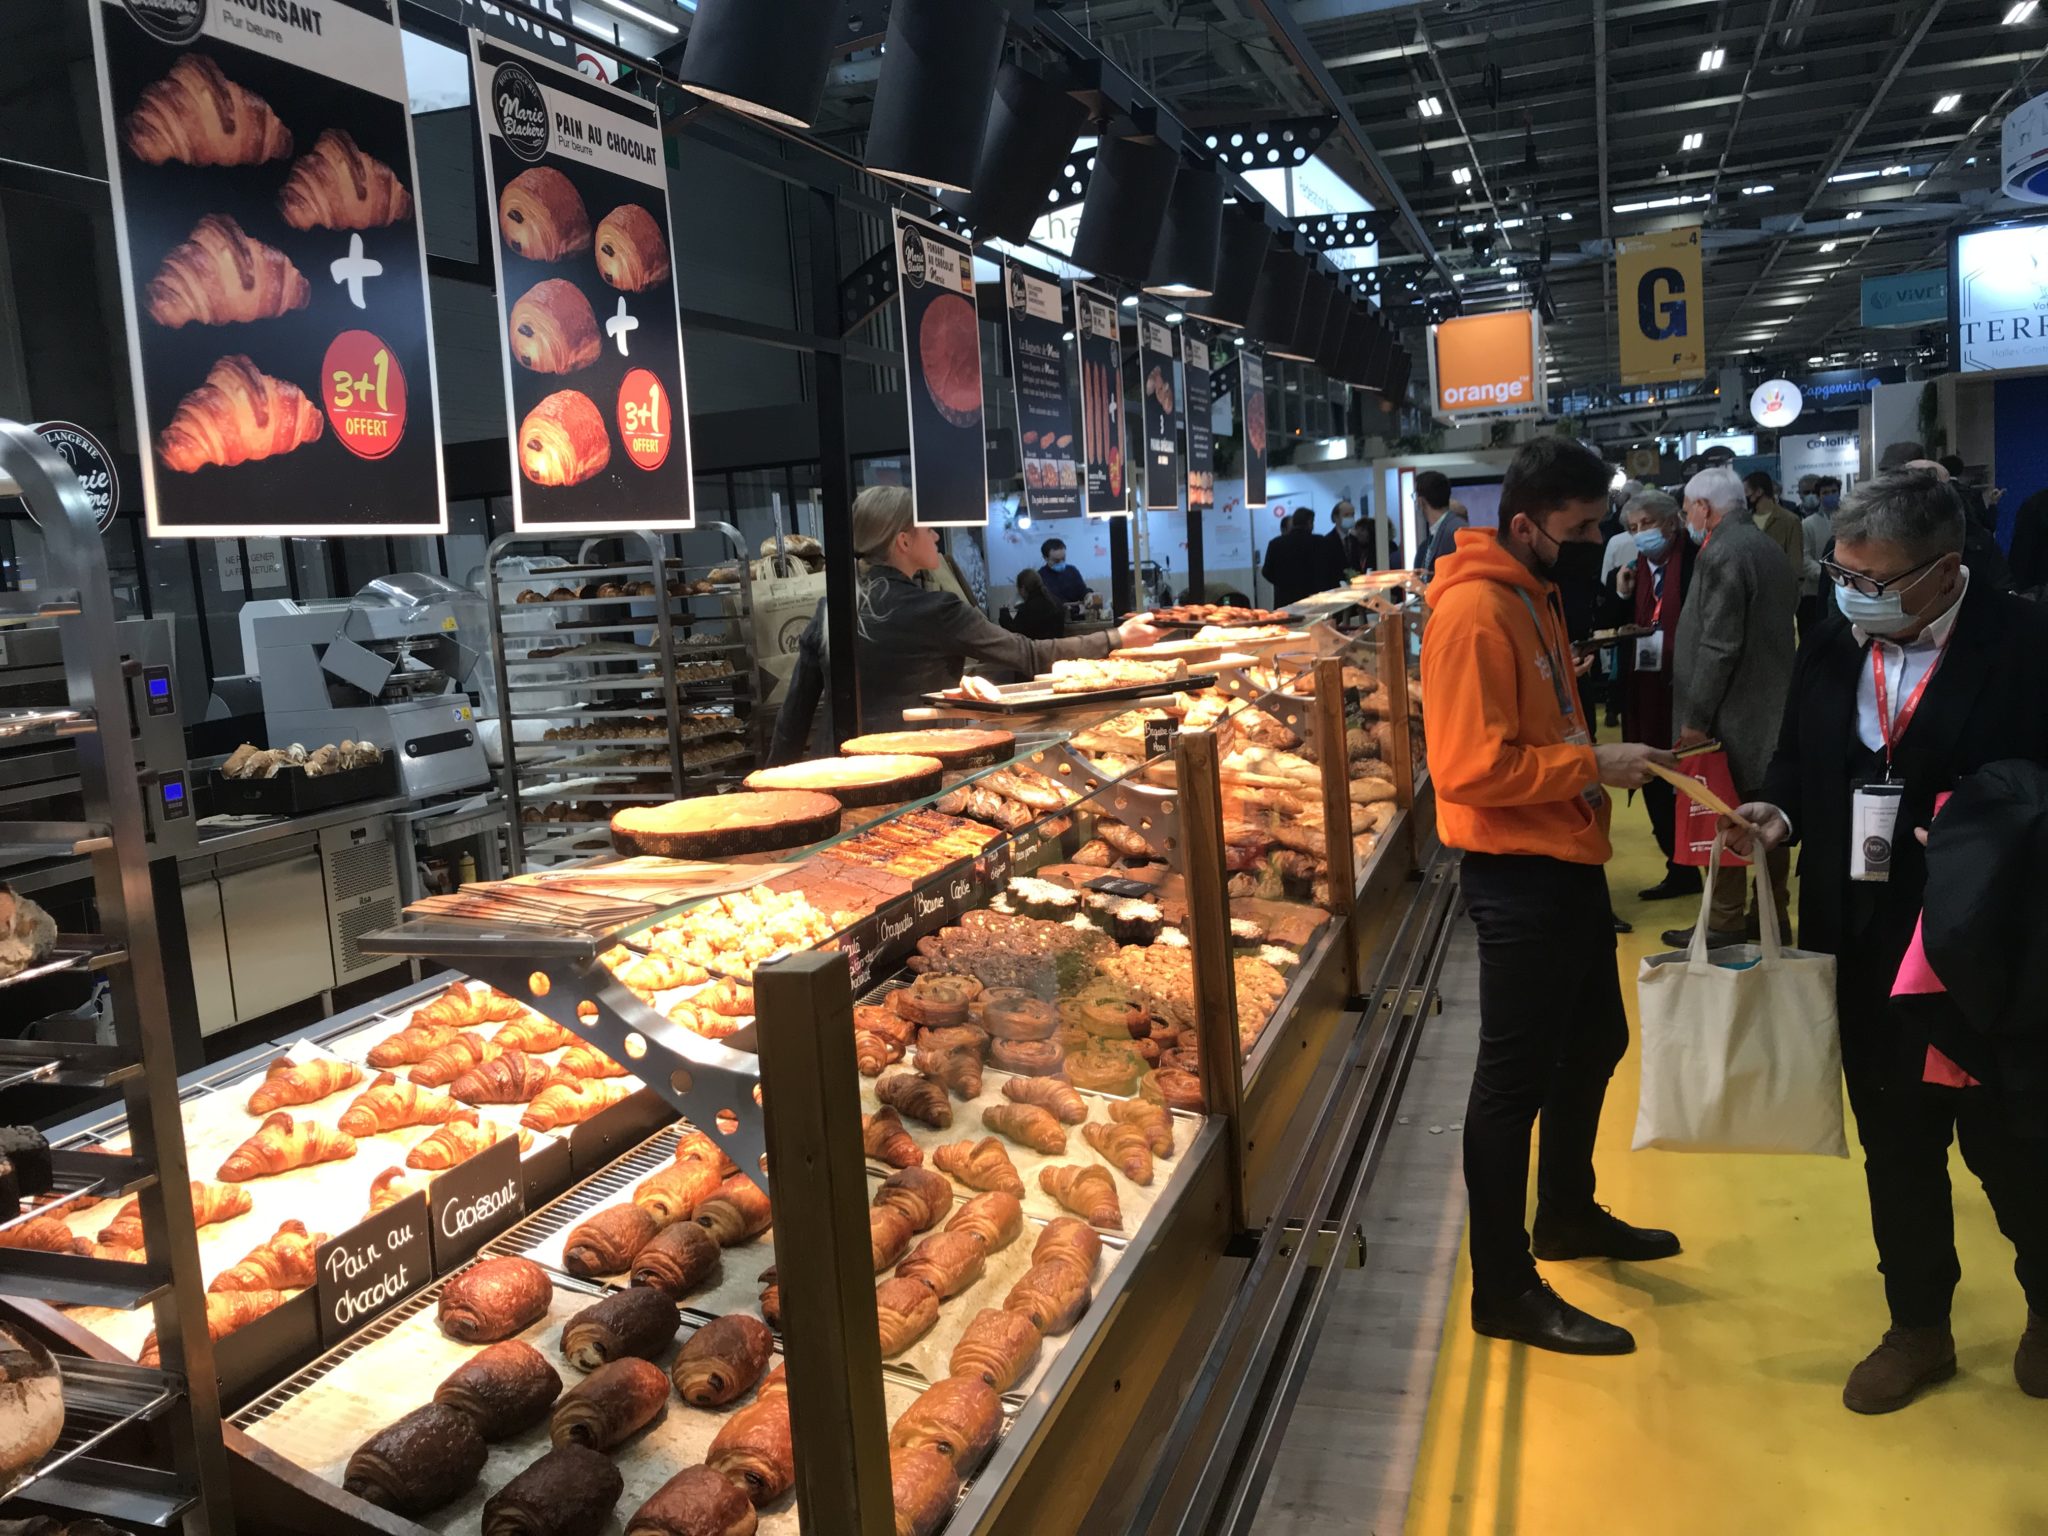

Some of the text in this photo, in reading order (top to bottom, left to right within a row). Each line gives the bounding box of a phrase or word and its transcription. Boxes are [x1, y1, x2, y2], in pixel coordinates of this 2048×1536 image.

[223, 10, 284, 43] Pur beurre
[500, 92, 545, 124] Marie
[503, 117, 545, 138] Blachère
[555, 112, 657, 166] PAIN AU CHOCOLAT
[558, 135, 593, 156] Pur beurre
[1689, 231, 1698, 246] 4
[1637, 266, 1688, 341] G
[1673, 353, 1682, 365] F
[1443, 379, 1522, 404] orange
[1800, 381, 1866, 399] Capgemini
[345, 417, 388, 438] OFFERT
[632, 437, 659, 453] OFFERT
[441, 1177, 518, 1239] Croissant
[324, 1223, 415, 1284] Pain au
